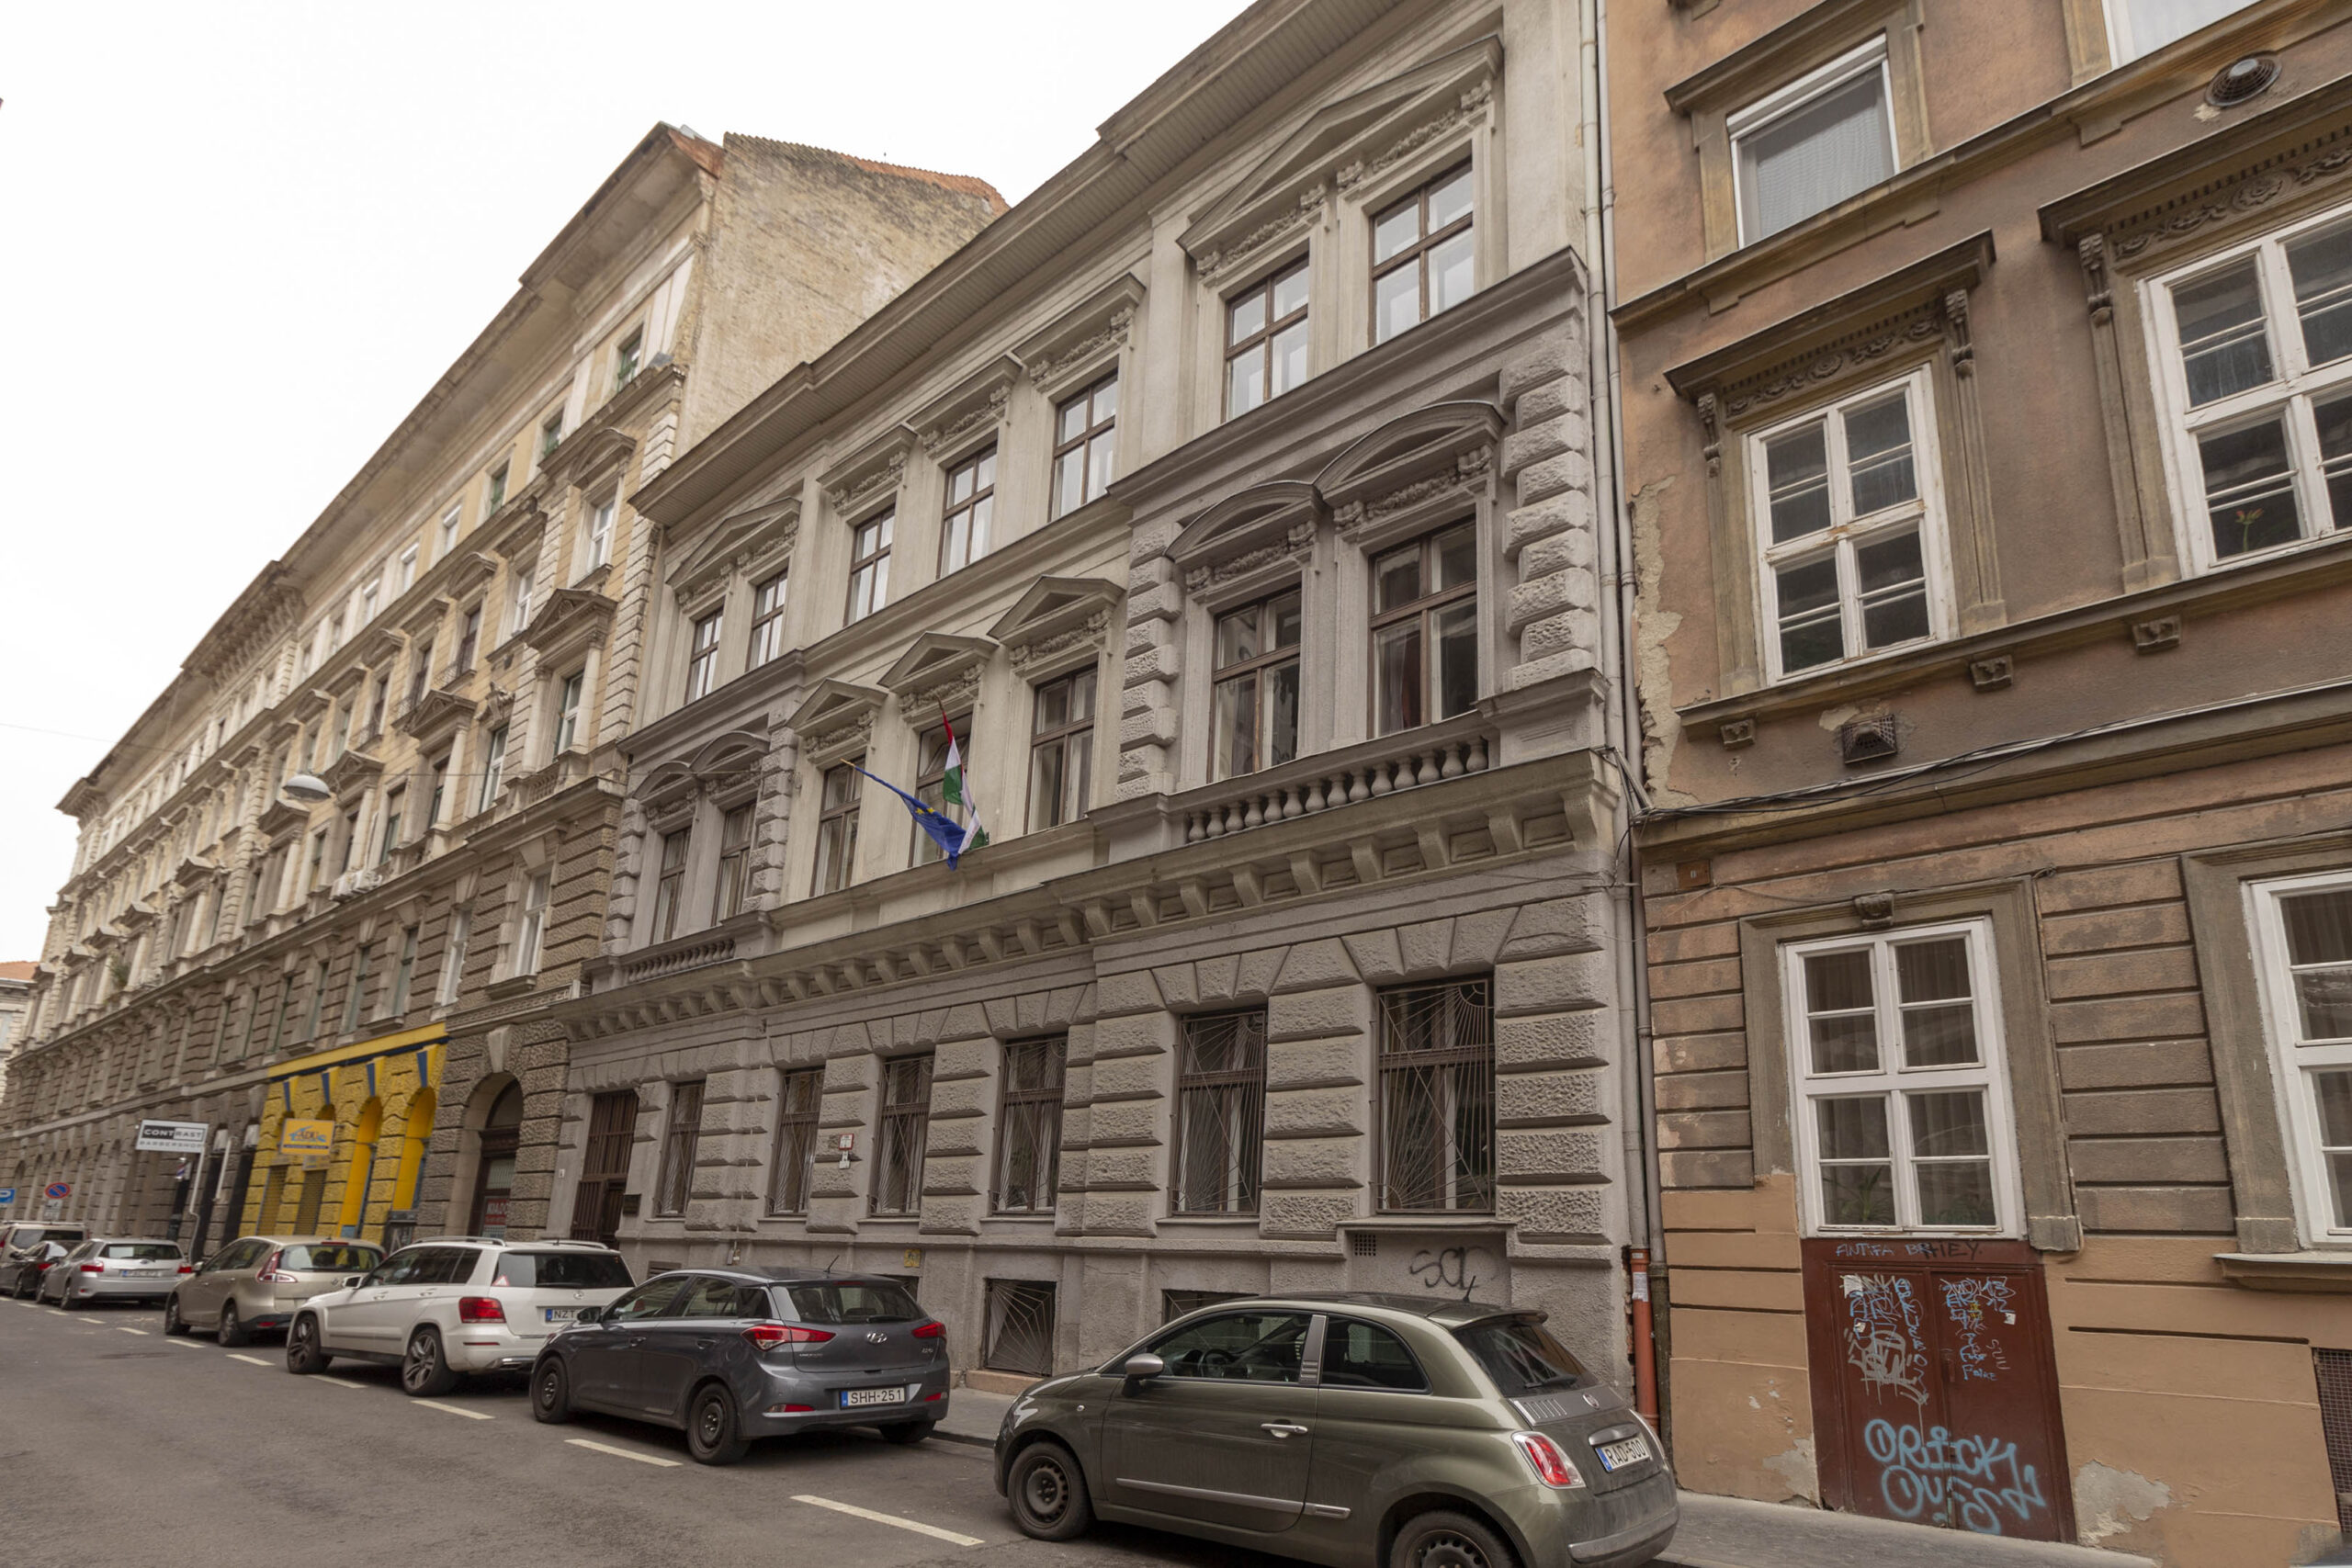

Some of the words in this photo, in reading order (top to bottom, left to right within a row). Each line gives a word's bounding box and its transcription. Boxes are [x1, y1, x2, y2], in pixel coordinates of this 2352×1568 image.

[143, 1129, 202, 1138] CONTRAST
[554, 1310, 575, 1319] NZT
[851, 1389, 902, 1404] SHH-251
[1605, 1439, 1646, 1466] RAD-500
